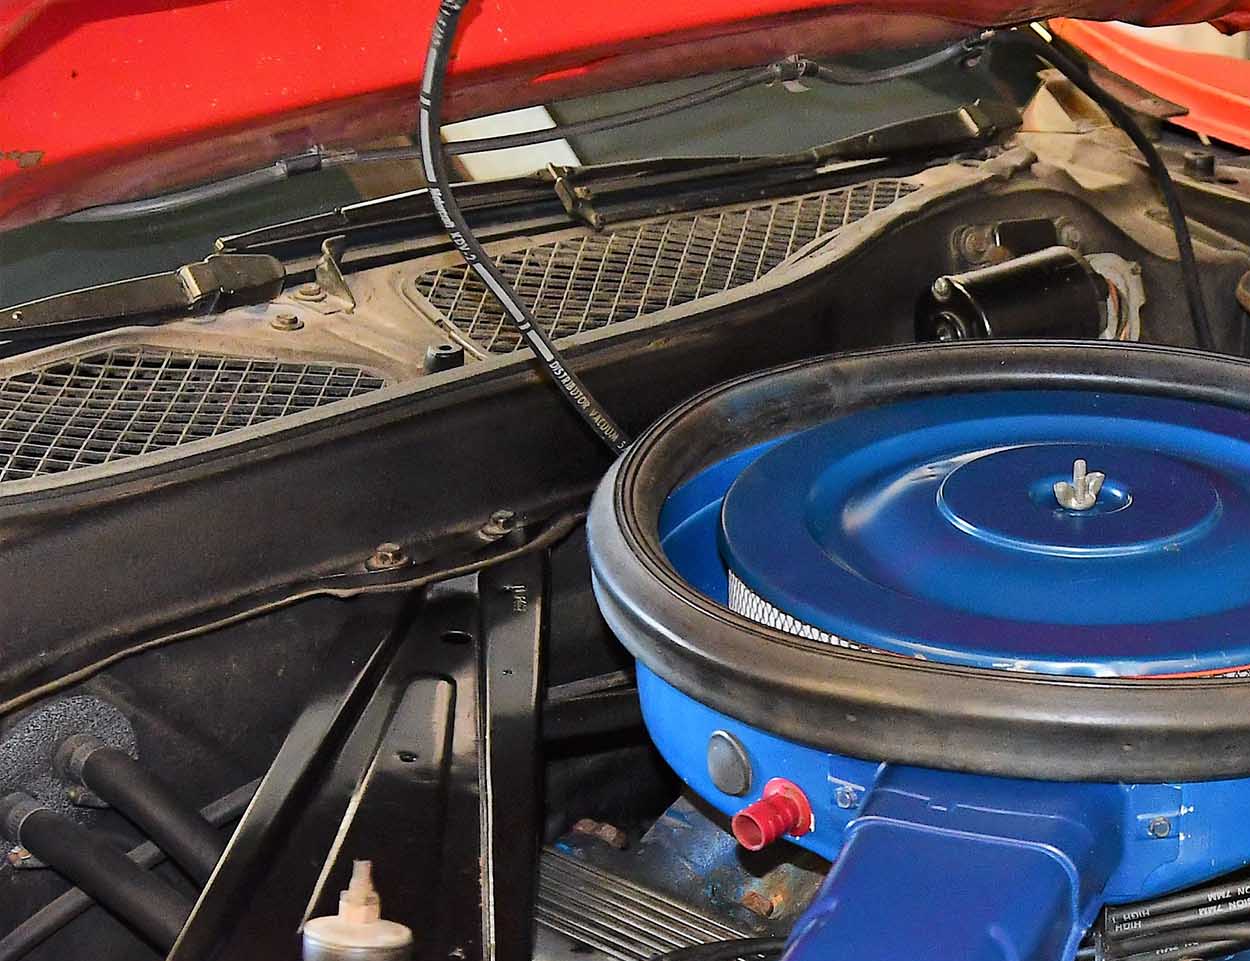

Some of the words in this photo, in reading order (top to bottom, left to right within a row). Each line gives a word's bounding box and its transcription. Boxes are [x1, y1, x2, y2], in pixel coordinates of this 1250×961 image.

[549, 360, 591, 410] DISTRIBUTOR
[589, 408, 620, 442] VACUUM
[1206, 889, 1233, 902] 7MM
[1122, 910, 1150, 920] HIGH
[1198, 902, 1225, 916] 7MM
